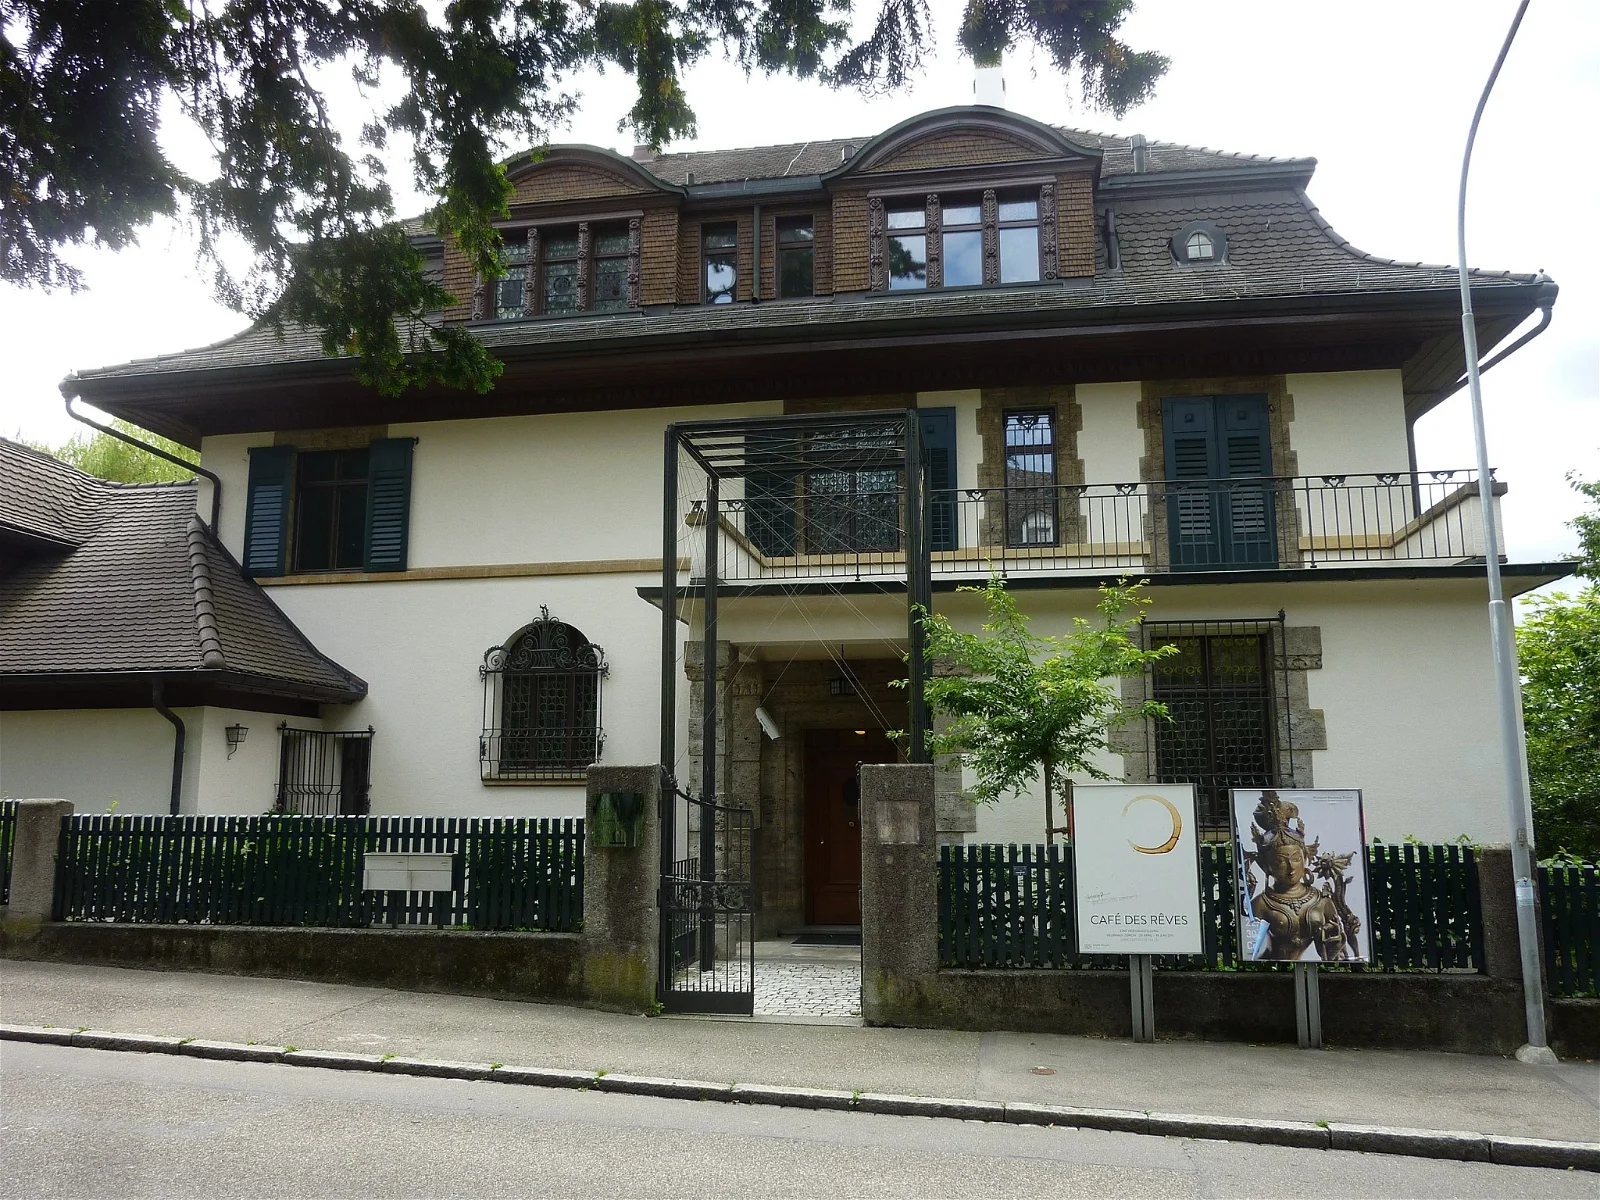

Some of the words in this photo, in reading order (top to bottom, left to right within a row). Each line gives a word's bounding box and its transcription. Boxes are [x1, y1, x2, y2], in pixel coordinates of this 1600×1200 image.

[1090, 912, 1121, 925] CAFÉ
[1124, 915, 1147, 925] DES
[1150, 913, 1188, 925] RÊVES
